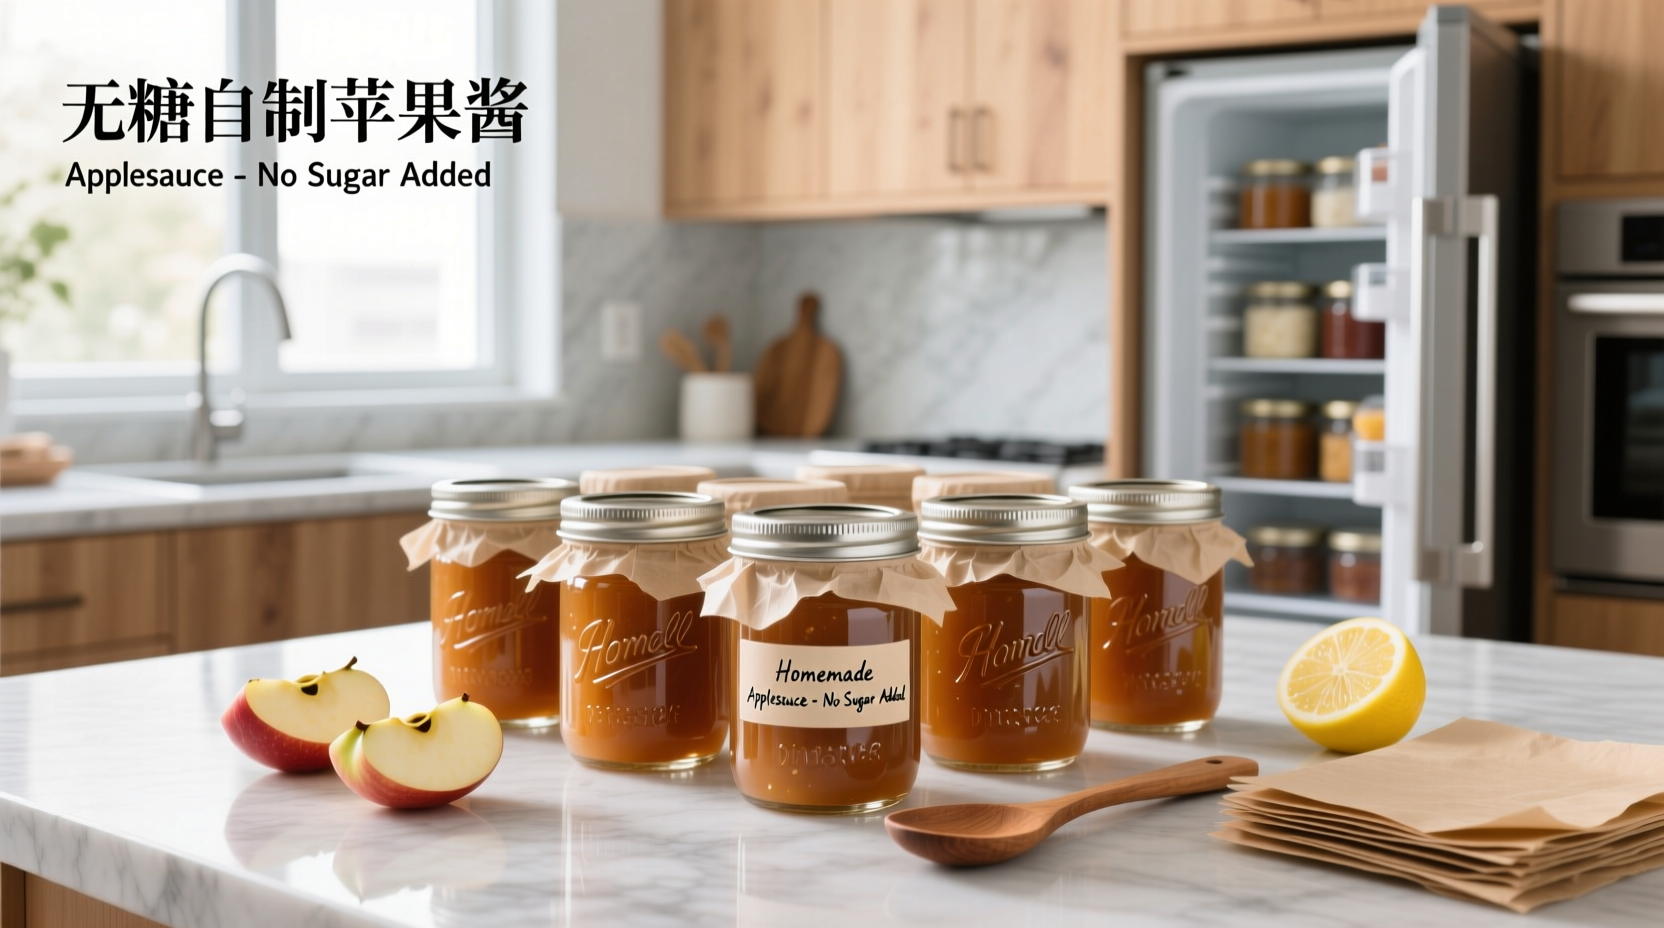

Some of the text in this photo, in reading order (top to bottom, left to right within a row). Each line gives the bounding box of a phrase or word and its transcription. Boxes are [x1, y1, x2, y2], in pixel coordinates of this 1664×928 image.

[775, 658, 874, 683] Homemade
[822, 691, 841, 708] No
[843, 690, 876, 713] Sugar
